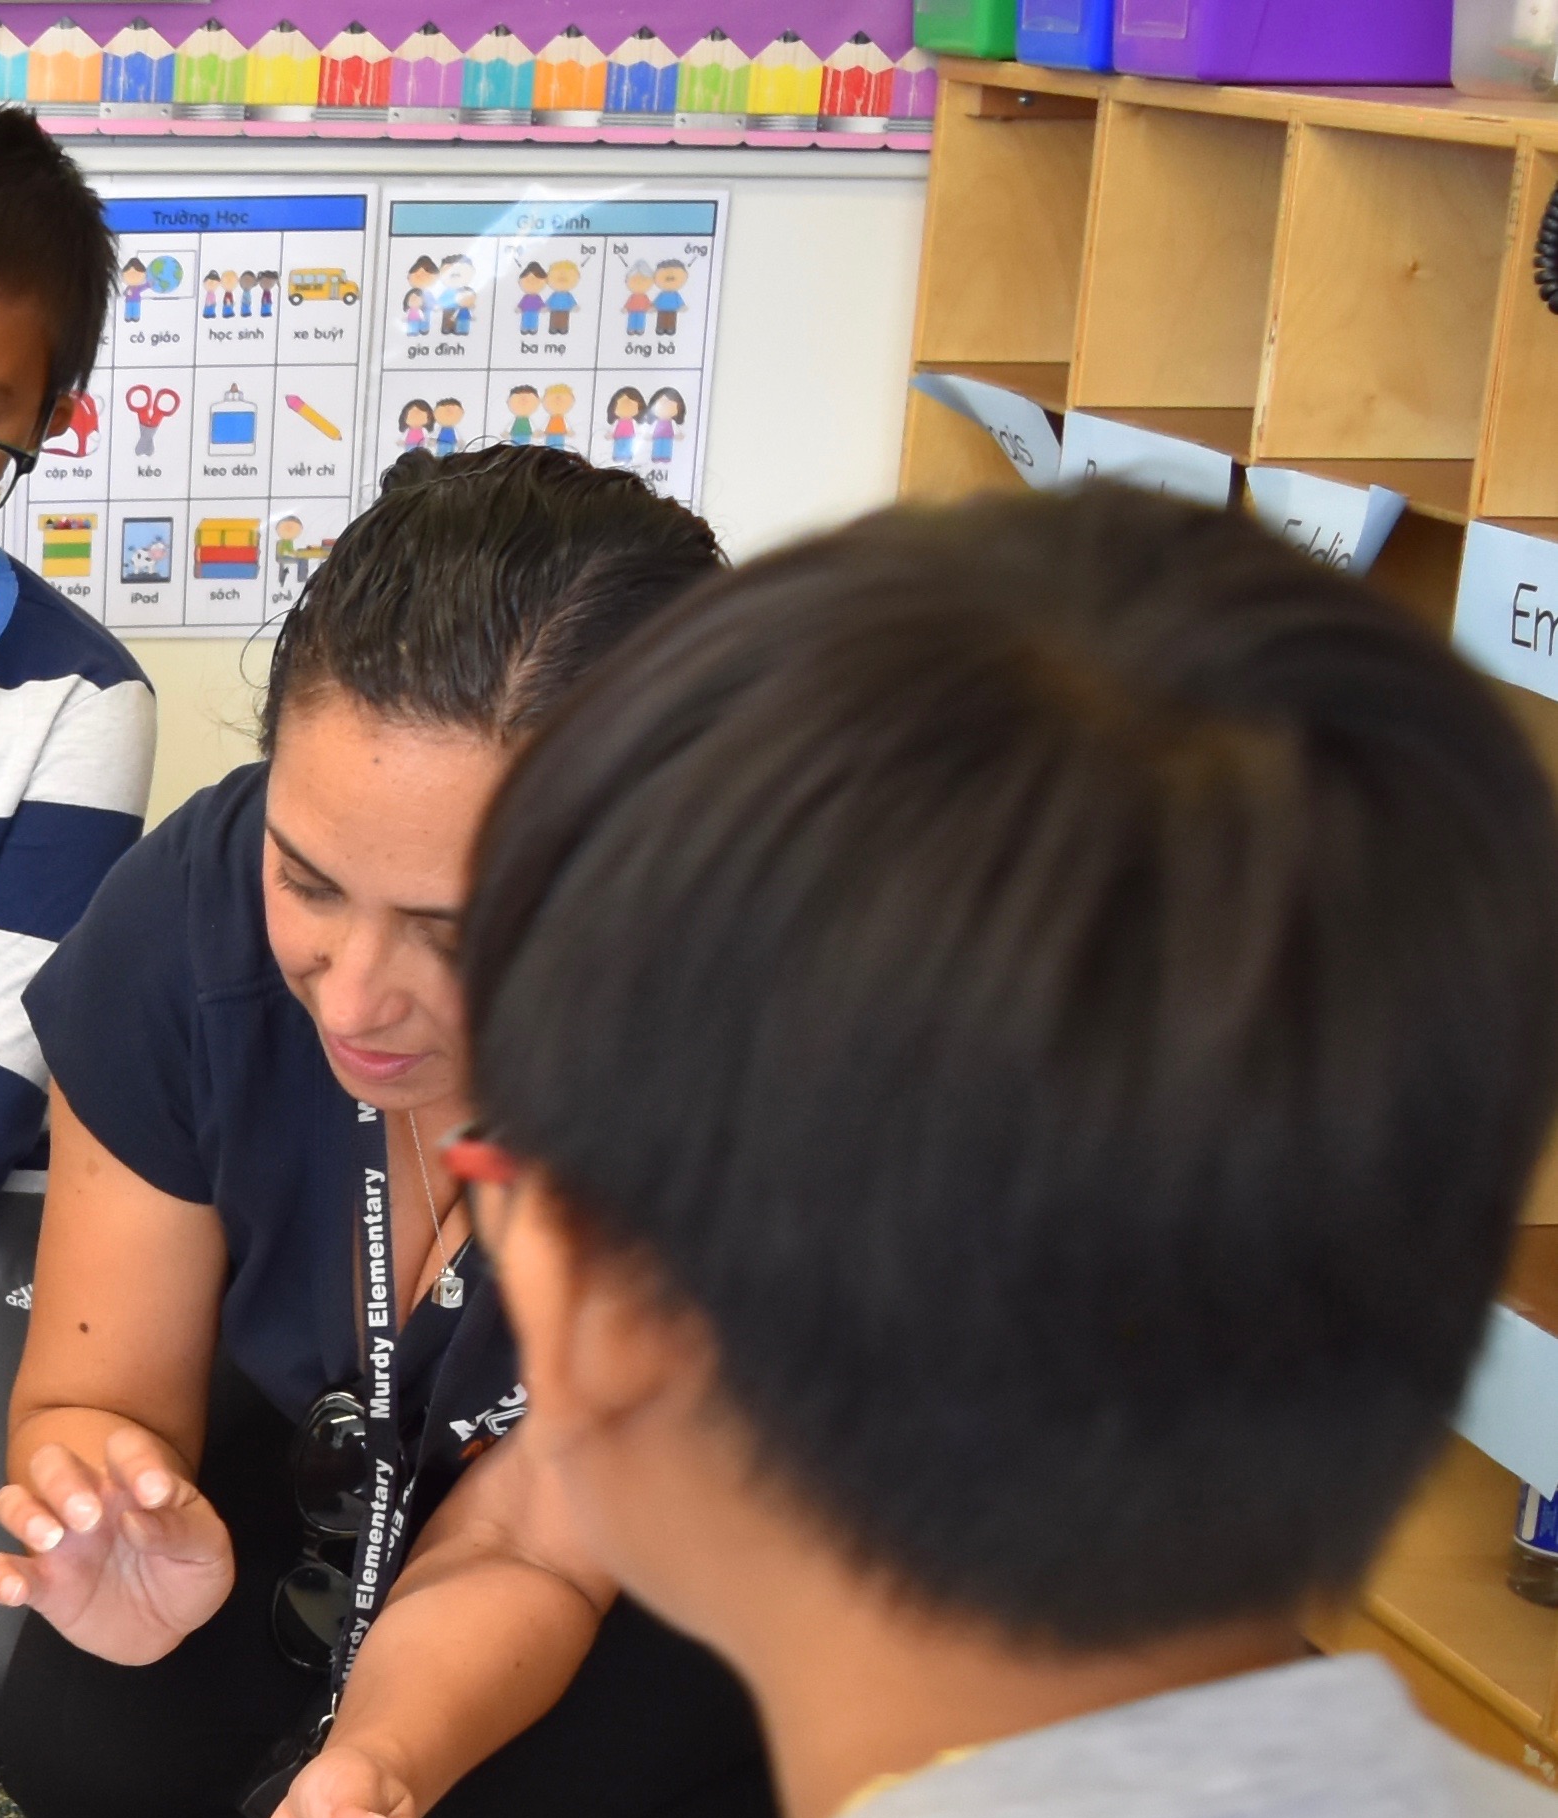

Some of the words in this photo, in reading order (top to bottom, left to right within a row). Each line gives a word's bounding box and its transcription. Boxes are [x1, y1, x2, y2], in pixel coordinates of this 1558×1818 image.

[237, 327, 265, 341] sinh
[293, 329, 309, 341] xe
[203, 464, 227, 477] keo
[131, 591, 159, 604] iPad
[363, 1167, 389, 1329] Elementary
[369, 1336, 395, 1420] Murdy
[355, 1458, 394, 1610] Elementary
